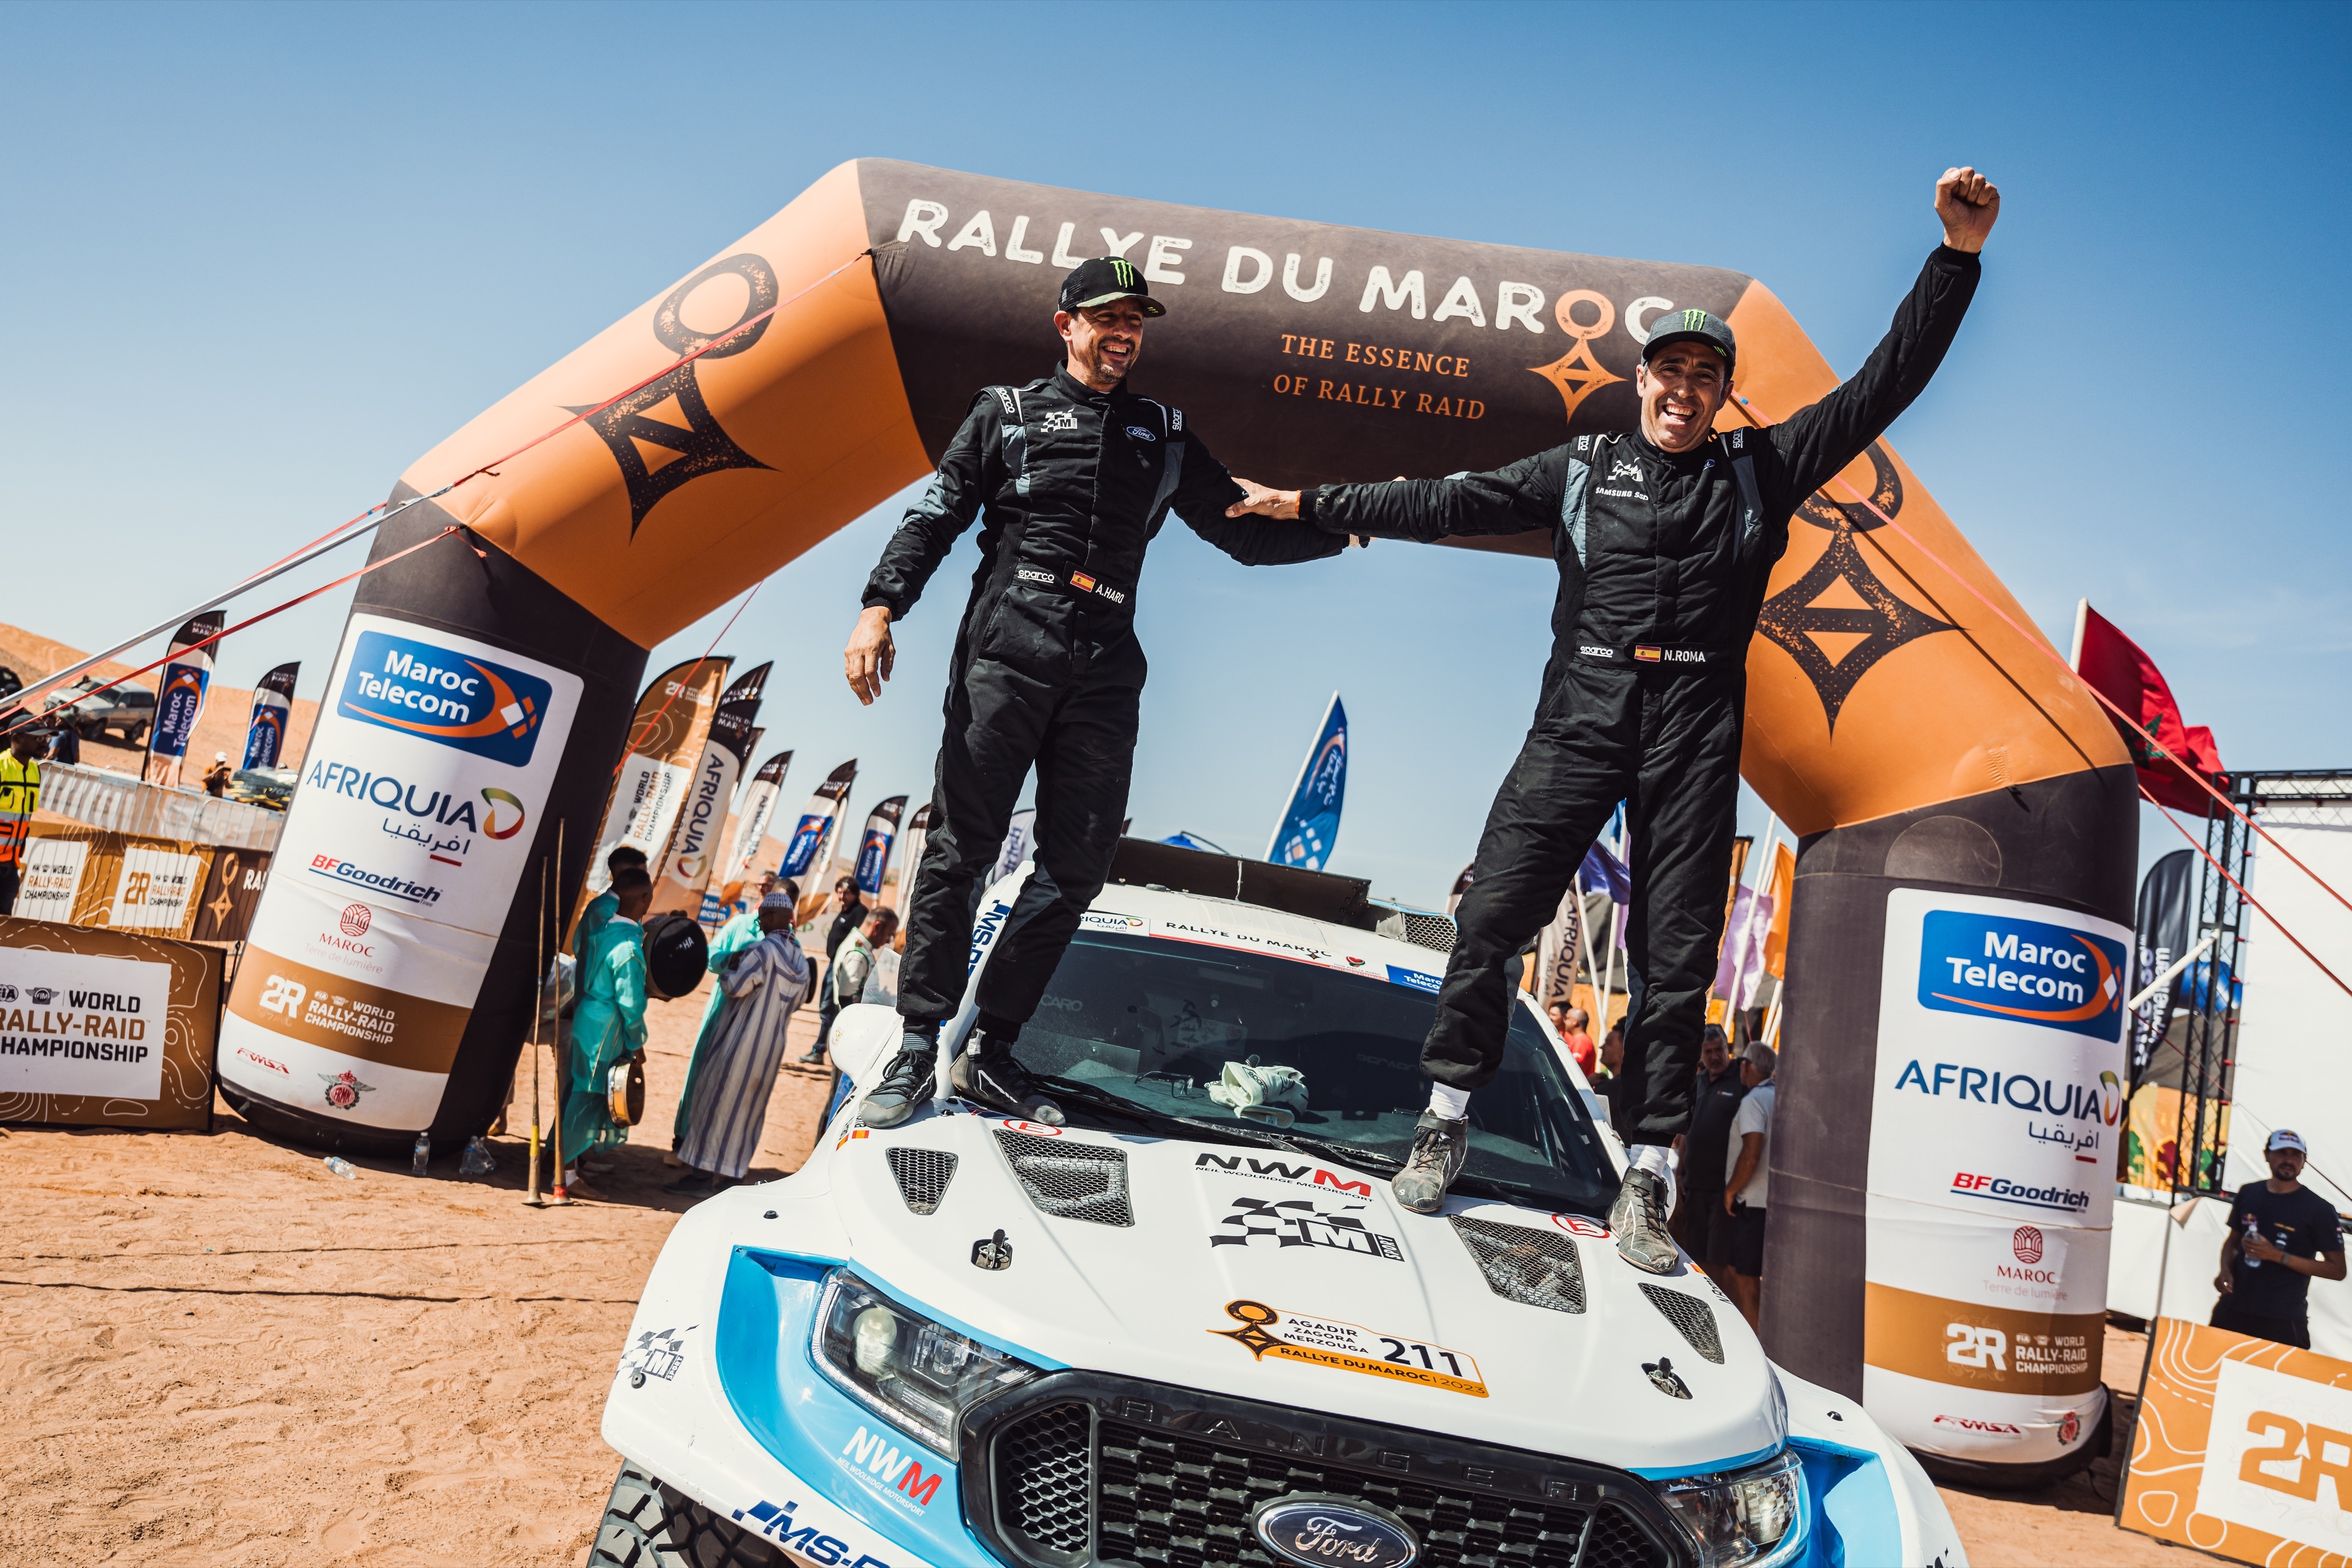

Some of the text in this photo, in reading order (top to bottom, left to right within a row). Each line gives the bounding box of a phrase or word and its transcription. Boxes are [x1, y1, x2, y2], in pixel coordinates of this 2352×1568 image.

[898, 199, 1674, 346] RALLYE DU MAROC
[1281, 334, 1470, 378] THE ESSENCE
[996, 387, 1015, 414] sparco
[1273, 374, 1486, 420] OF RALLY RAID
[1132, 427, 1150, 439] Ford
[1172, 408, 1182, 431] sparc
[1595, 487, 1649, 501] SAMSUNG SSD
[1018, 570, 1054, 584] sparco
[1095, 583, 1125, 604] A.HARO
[1580, 646, 1614, 657] sparco
[1664, 649, 1706, 663] N.ROMA
[384, 650, 479, 697] Maroc
[163, 692, 182, 734] Maroc
[358, 671, 470, 723] Telecom
[173, 695, 197, 748] Telecom
[306, 759, 477, 834] AFRIQUIA
[634, 771, 650, 804] WORLD
[682, 753, 724, 854] AFRIQUIA
[633, 771, 662, 839] RALLY-RAID
[645, 772, 672, 842] CHAMPIONSHIP
[28, 875, 72, 889] RALLY-RAID
[52, 865, 74, 874] WORLD
[311, 854, 440, 902] BFGoodrich
[25, 890, 69, 901] CHAMPIONSHIP
[123, 872, 151, 905] 2R
[319, 932, 376, 958] MAROC
[1166, 922, 1332, 957] RALLYE DU MAROC
[1552, 906, 1577, 997] AFRIQUIA
[1984, 931, 2086, 974] Maroc
[305, 943, 384, 974] Terre de lumière
[1403, 975, 1441, 990] Teleco
[1413, 972, 1442, 986] Maro
[1945, 957, 2083, 1004] Telecom
[69, 990, 141, 1013] WORLD
[259, 974, 307, 1020] 2R
[353, 1001, 395, 1020] WORLD
[1040, 994, 1083, 1012] CARO
[304, 1012, 394, 1044] CHAMPIONSHIP
[308, 1000, 395, 1034] RALLY-RAID
[1, 1036, 148, 1063] HAMPIONSHIP
[1894, 1059, 2102, 1124] AFRIQUIA
[1195, 1153, 1371, 1197] NWM
[1223, 1168, 1293, 1184] WOOLRIDGE
[1296, 1182, 1375, 1202] MOTORSPORT
[1952, 1172, 2089, 1207] BFGoodrich
[1306, 1221, 1402, 1260] M SPORT
[1983, 1279, 2012, 1295] Terre
[2014, 1284, 2028, 1297] de
[1997, 1265, 2056, 1284] MAROC
[1283, 1333, 1369, 1354] MERZOUGA
[1288, 1318, 1359, 1337] AGADIR
[1294, 1327, 1355, 1344] ZAGORA
[2055, 1336, 2085, 1346] WORLD
[1379, 1338, 1463, 1377] 211
[1947, 1322, 2007, 1370] 2R
[2016, 1345, 2087, 1361] RALLY-RAID
[644, 1350, 683, 1380] M SPORT
[1280, 1347, 1340, 1364] RALLYE
[1440, 1378, 1485, 1394] 2023
[2016, 1361, 2088, 1374] CHAMPIONSHIP
[1122, 1397, 1578, 1500] RANGER
[842, 1426, 943, 1506] NWM
[837, 1457, 926, 1517] NEIL WOOLRIDGE MOTORSPORT
[1295, 1516, 1380, 1565] Ford
